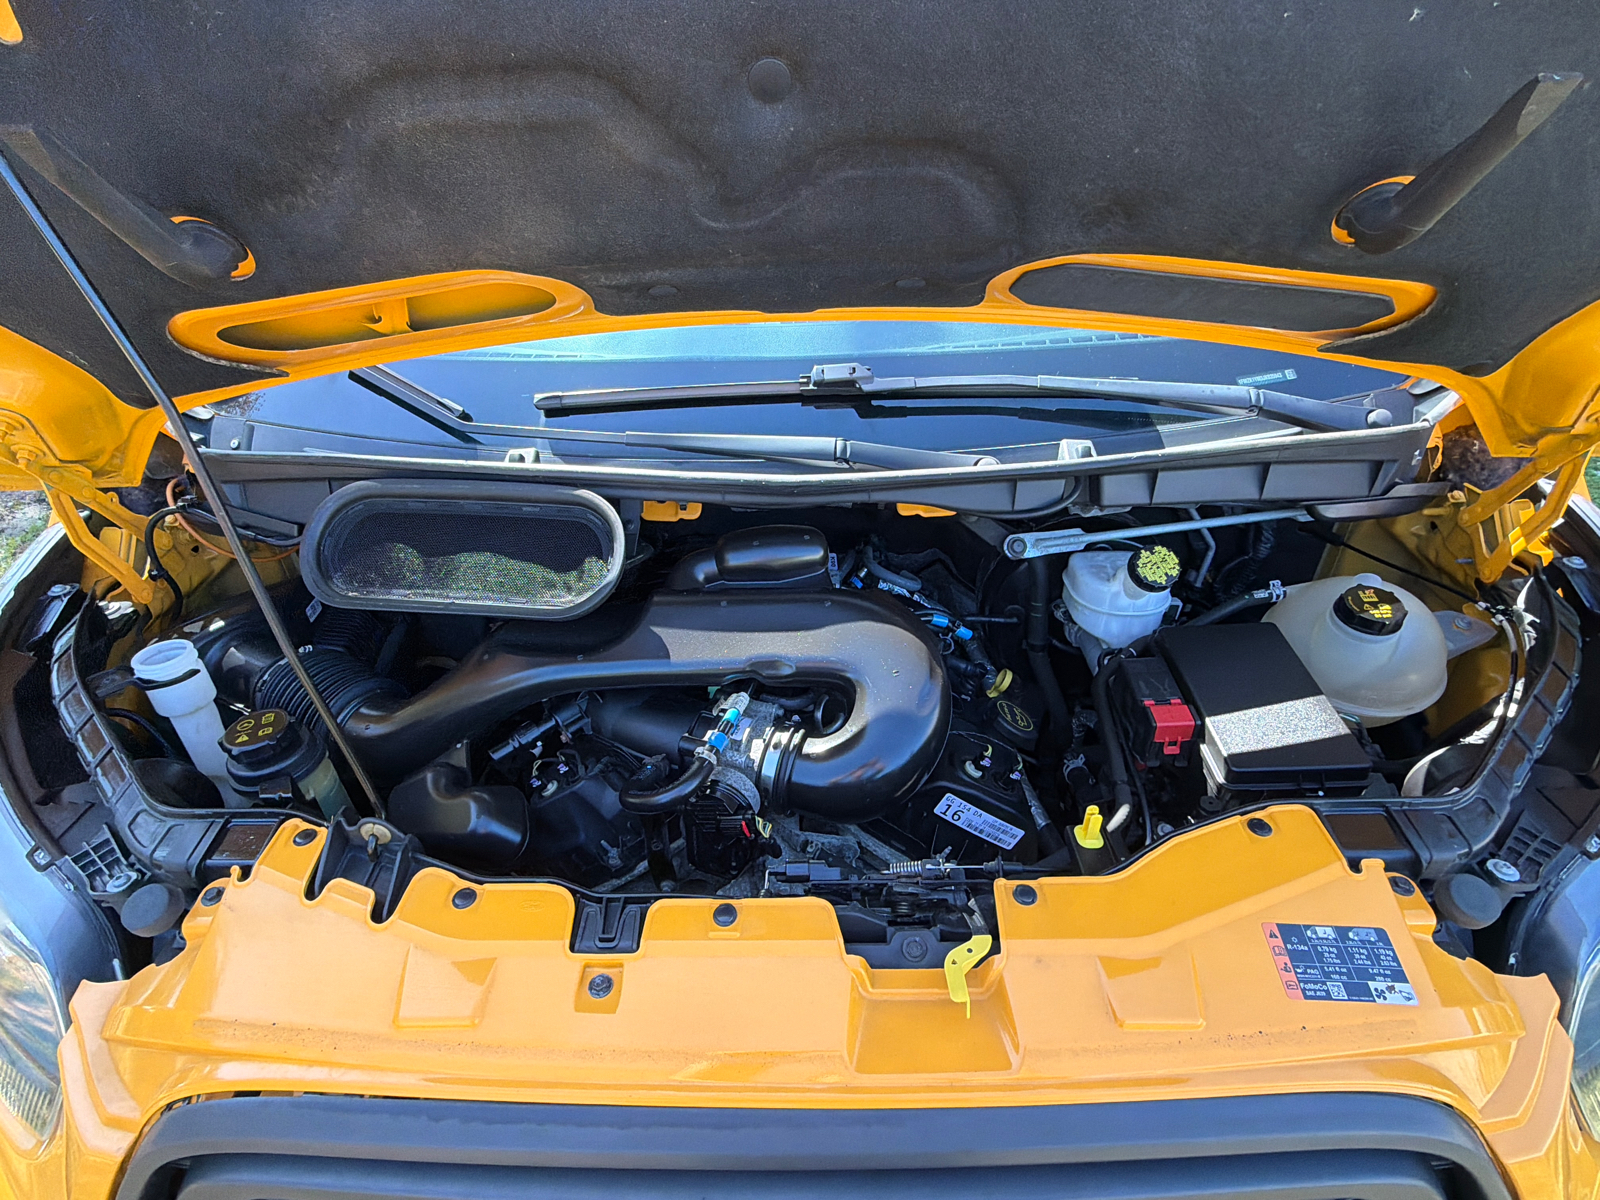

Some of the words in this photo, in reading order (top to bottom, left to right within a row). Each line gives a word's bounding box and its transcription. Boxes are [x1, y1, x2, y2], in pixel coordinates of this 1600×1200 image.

[940, 803, 965, 822] 16
[957, 802, 971, 812] 154
[972, 810, 983, 819] DA
